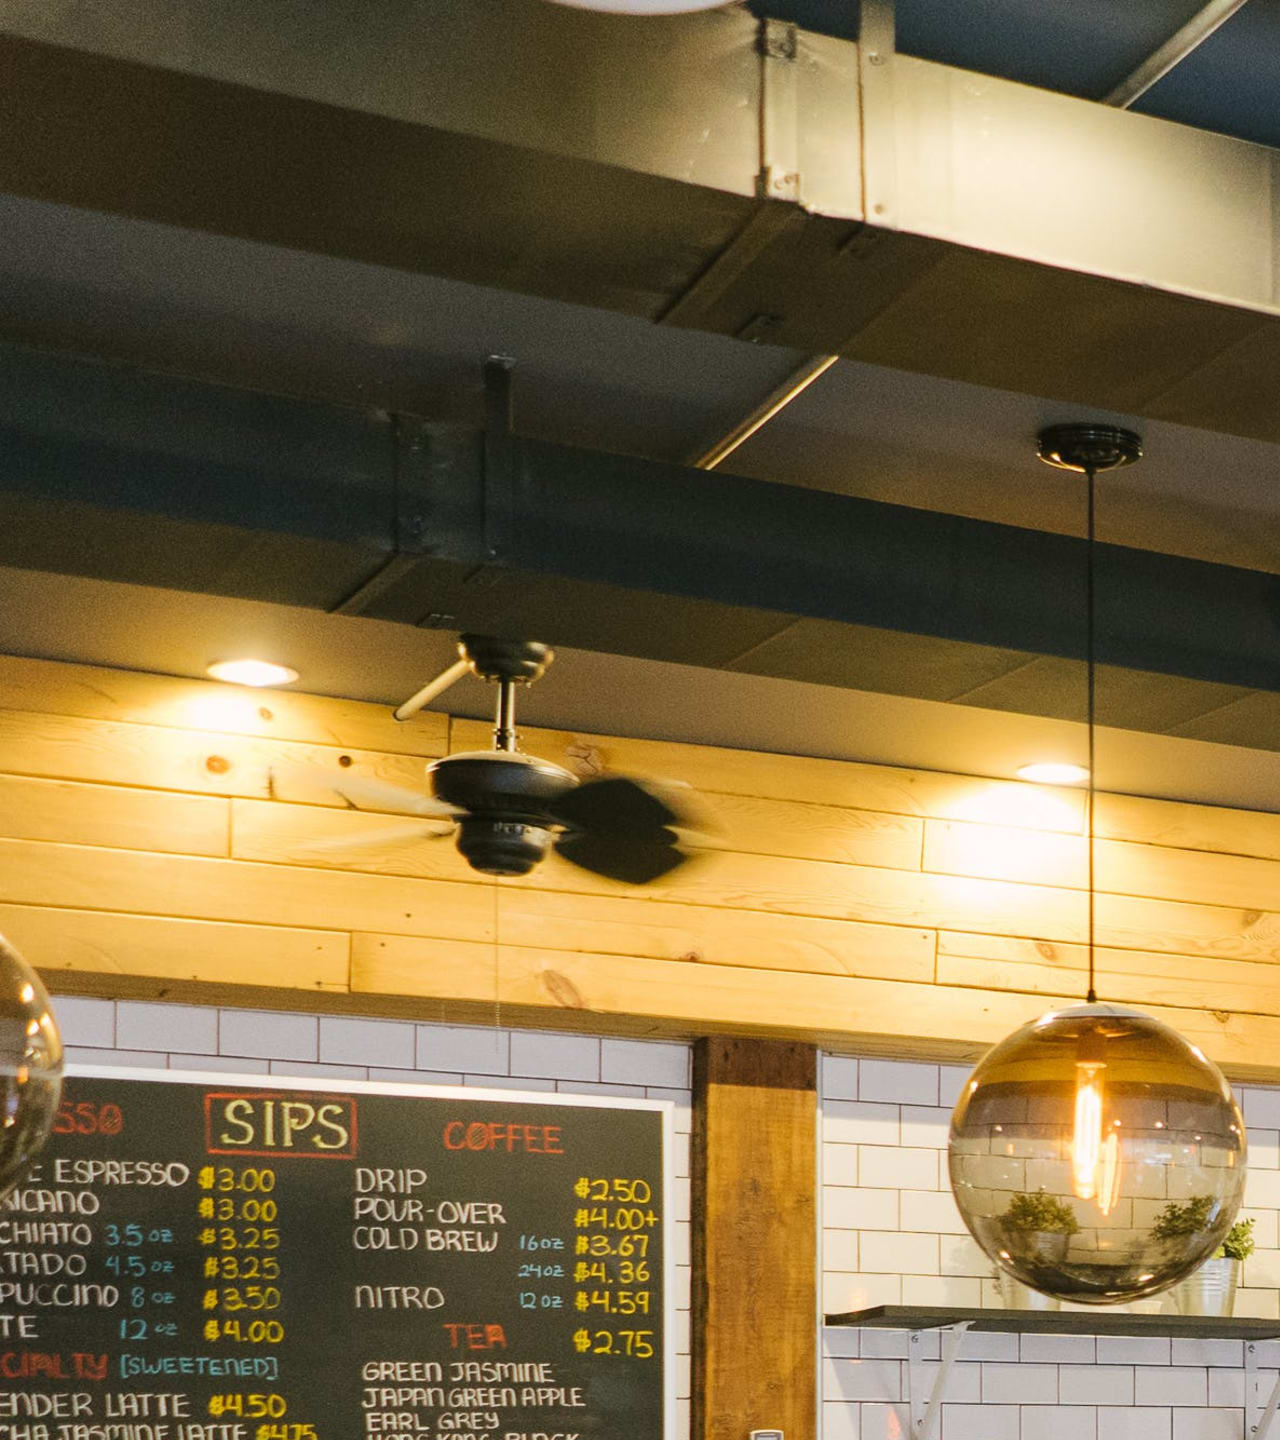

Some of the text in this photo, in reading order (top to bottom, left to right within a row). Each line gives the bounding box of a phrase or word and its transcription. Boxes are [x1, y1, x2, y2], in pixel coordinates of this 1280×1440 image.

[221, 1099, 349, 1150] SIPS
[444, 1121, 564, 1154] COFFEE
[55, 1159, 190, 1186] ESPRESSO
[198, 1166, 277, 1192] $3.00
[355, 1168, 651, 1203] DRIP $2.50
[198, 1197, 278, 1222] $3.00
[353, 1197, 659, 1230] POUR-OVER $4.00+
[104, 1224, 144, 1247] 3.5
[198, 1227, 281, 1250] $3.25
[353, 1227, 419, 1250] COLD
[426, 1229, 499, 1252] BREW
[574, 1234, 650, 1257] $3.67
[0, 1252, 87, 1276] TADO
[105, 1255, 146, 1277] 4.5
[204, 1256, 281, 1280] $3.25
[573, 1260, 651, 1284] $4.36
[131, 1287, 145, 1308] 8
[355, 1285, 445, 1309] NITRO
[574, 1290, 650, 1315] $4.59
[120, 1319, 148, 1339] 12
[203, 1319, 285, 1343] $4.00
[443, 1323, 507, 1349] TEA
[572, 1328, 654, 1358] $2.75
[362, 1361, 556, 1383] GREEN JASMINE
[105, 1393, 191, 1418] LATTE
[208, 1393, 288, 1418] $4.50
[362, 1387, 586, 1408] JAPAN GREEN APPLE
[366, 1411, 500, 1432] EARL GREY
